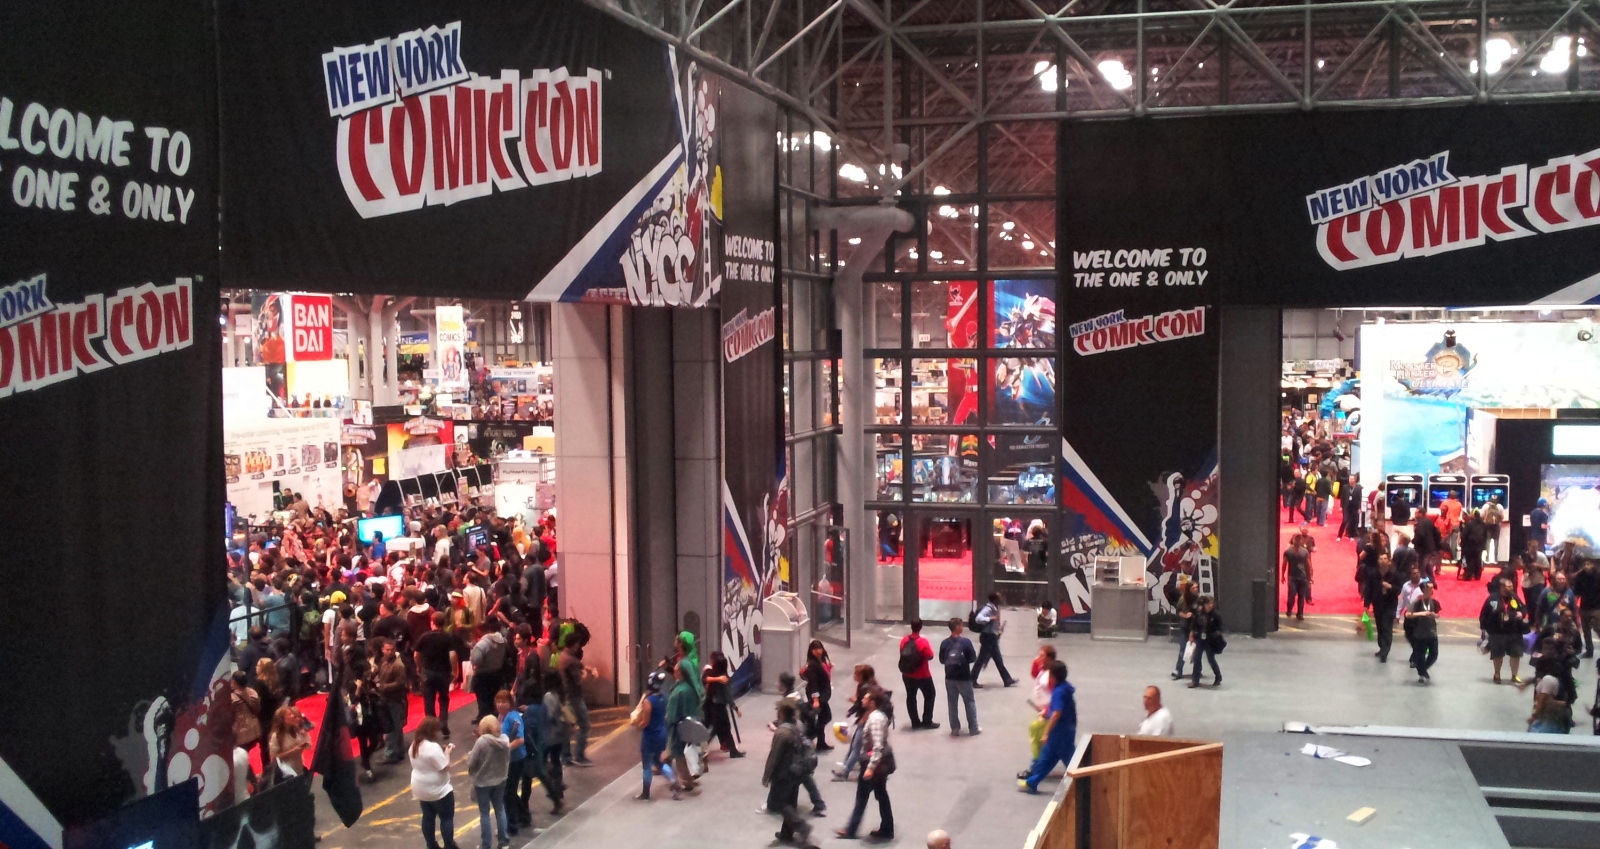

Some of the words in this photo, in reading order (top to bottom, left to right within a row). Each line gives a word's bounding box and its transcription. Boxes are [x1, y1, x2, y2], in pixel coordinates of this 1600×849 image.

[325, 43, 391, 110] NEW
[395, 34, 463, 90] YORK
[144, 126, 192, 177] TO
[347, 80, 514, 204] COMIC
[524, 79, 600, 175] CON
[12, 165, 80, 212] ONE
[88, 175, 112, 217] &
[122, 181, 195, 225] ONLY
[1308, 179, 1369, 222] NEW
[1374, 155, 1450, 199] YORK
[1325, 173, 1518, 263] COMIC
[724, 234, 764, 261] WELCOME
[764, 240, 775, 263] TO
[1072, 248, 1174, 270] WELCOME
[1178, 247, 1208, 267] TO
[724, 261, 740, 280] THE
[740, 263, 754, 281] ONE
[754, 264, 760, 282] &
[760, 265, 775, 284] ONLY
[1073, 271, 1106, 288] THE
[1109, 271, 1143, 287] ONE
[1146, 270, 1160, 287] &
[1164, 269, 1209, 286] ONLY
[0, 279, 48, 325] ORK
[294, 302, 330, 329] BAN
[109, 285, 191, 358] CON
[439, 331, 462, 343] COMICS
[725, 319, 757, 361] COMIC
[757, 309, 775, 344] CON
[1070, 321, 1095, 337] NEW
[1095, 311, 1125, 329] YORK
[1076, 319, 1151, 353] COMIC
[1155, 309, 1204, 339] CON
[295, 328, 325, 353] DAI
[1395, 369, 1436, 380] HUNTER
[1411, 379, 1469, 389] ULTIMATE
